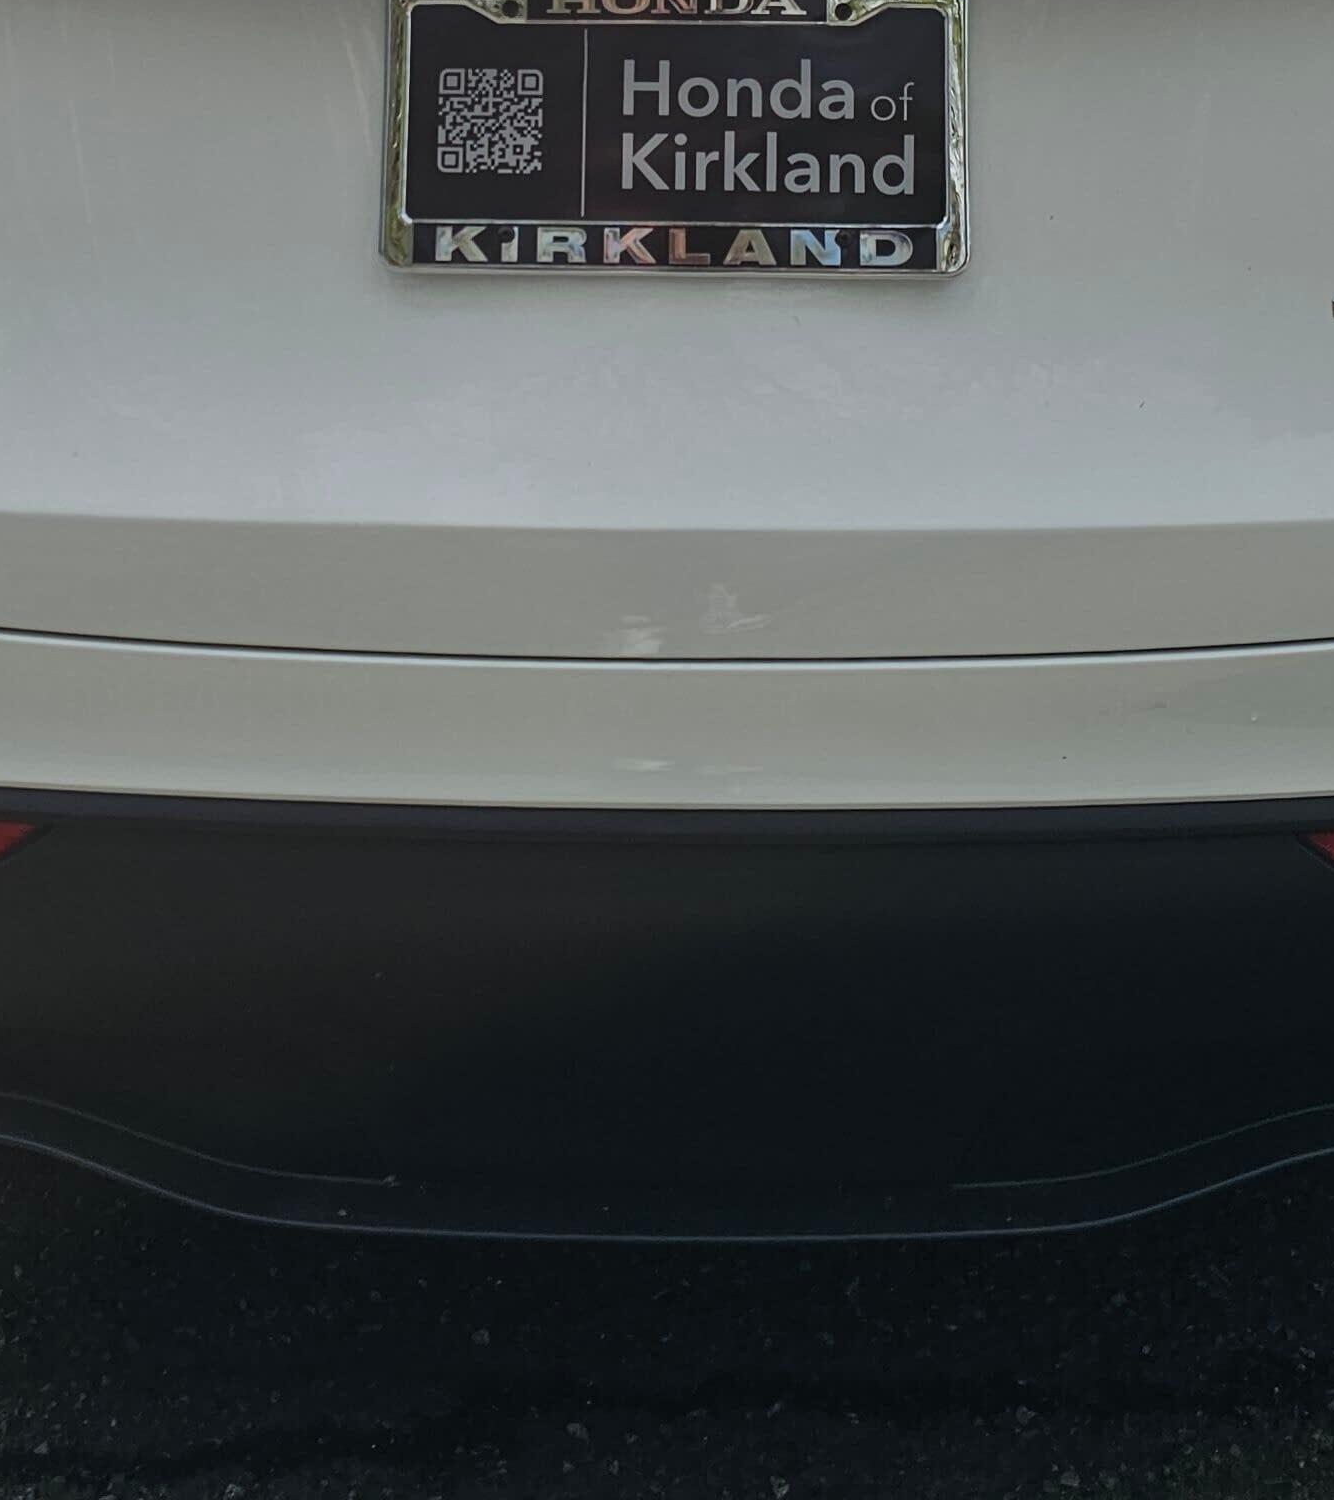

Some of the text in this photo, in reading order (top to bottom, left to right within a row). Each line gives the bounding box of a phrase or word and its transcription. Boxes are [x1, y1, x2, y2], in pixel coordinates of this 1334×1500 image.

[620, 59, 915, 122] Honda of
[620, 131, 916, 195] Kirkland
[434, 225, 913, 267] KIRKLAND
